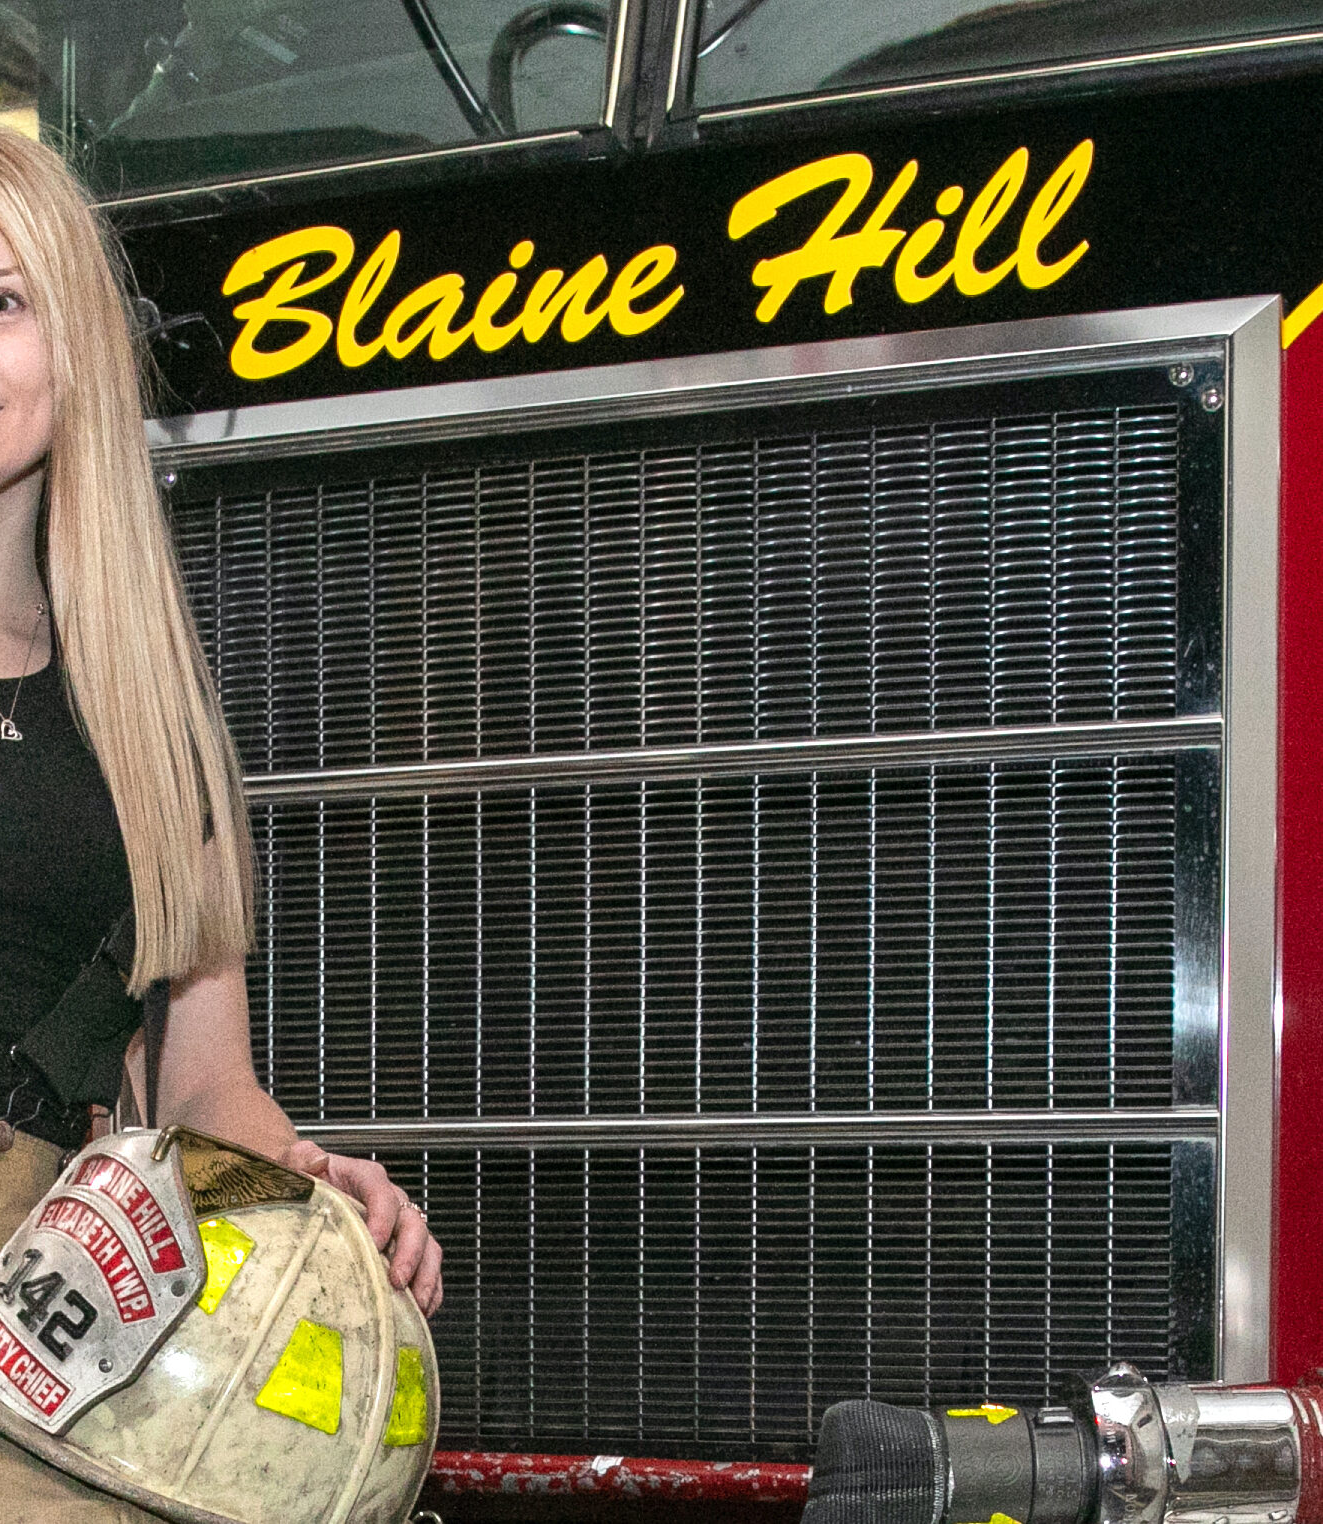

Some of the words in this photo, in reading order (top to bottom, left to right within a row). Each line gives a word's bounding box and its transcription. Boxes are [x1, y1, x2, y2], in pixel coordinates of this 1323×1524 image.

[222, 225, 684, 379] Blaine
[727, 139, 1093, 322] Hill
[40, 1201, 121, 1266] ELIZABETH
[107, 1253, 150, 1320] TWP.
[79, 1157, 146, 1208] BLAINE
[130, 1198, 177, 1262] HILL
[9, 1355, 66, 1411] CHIEF
